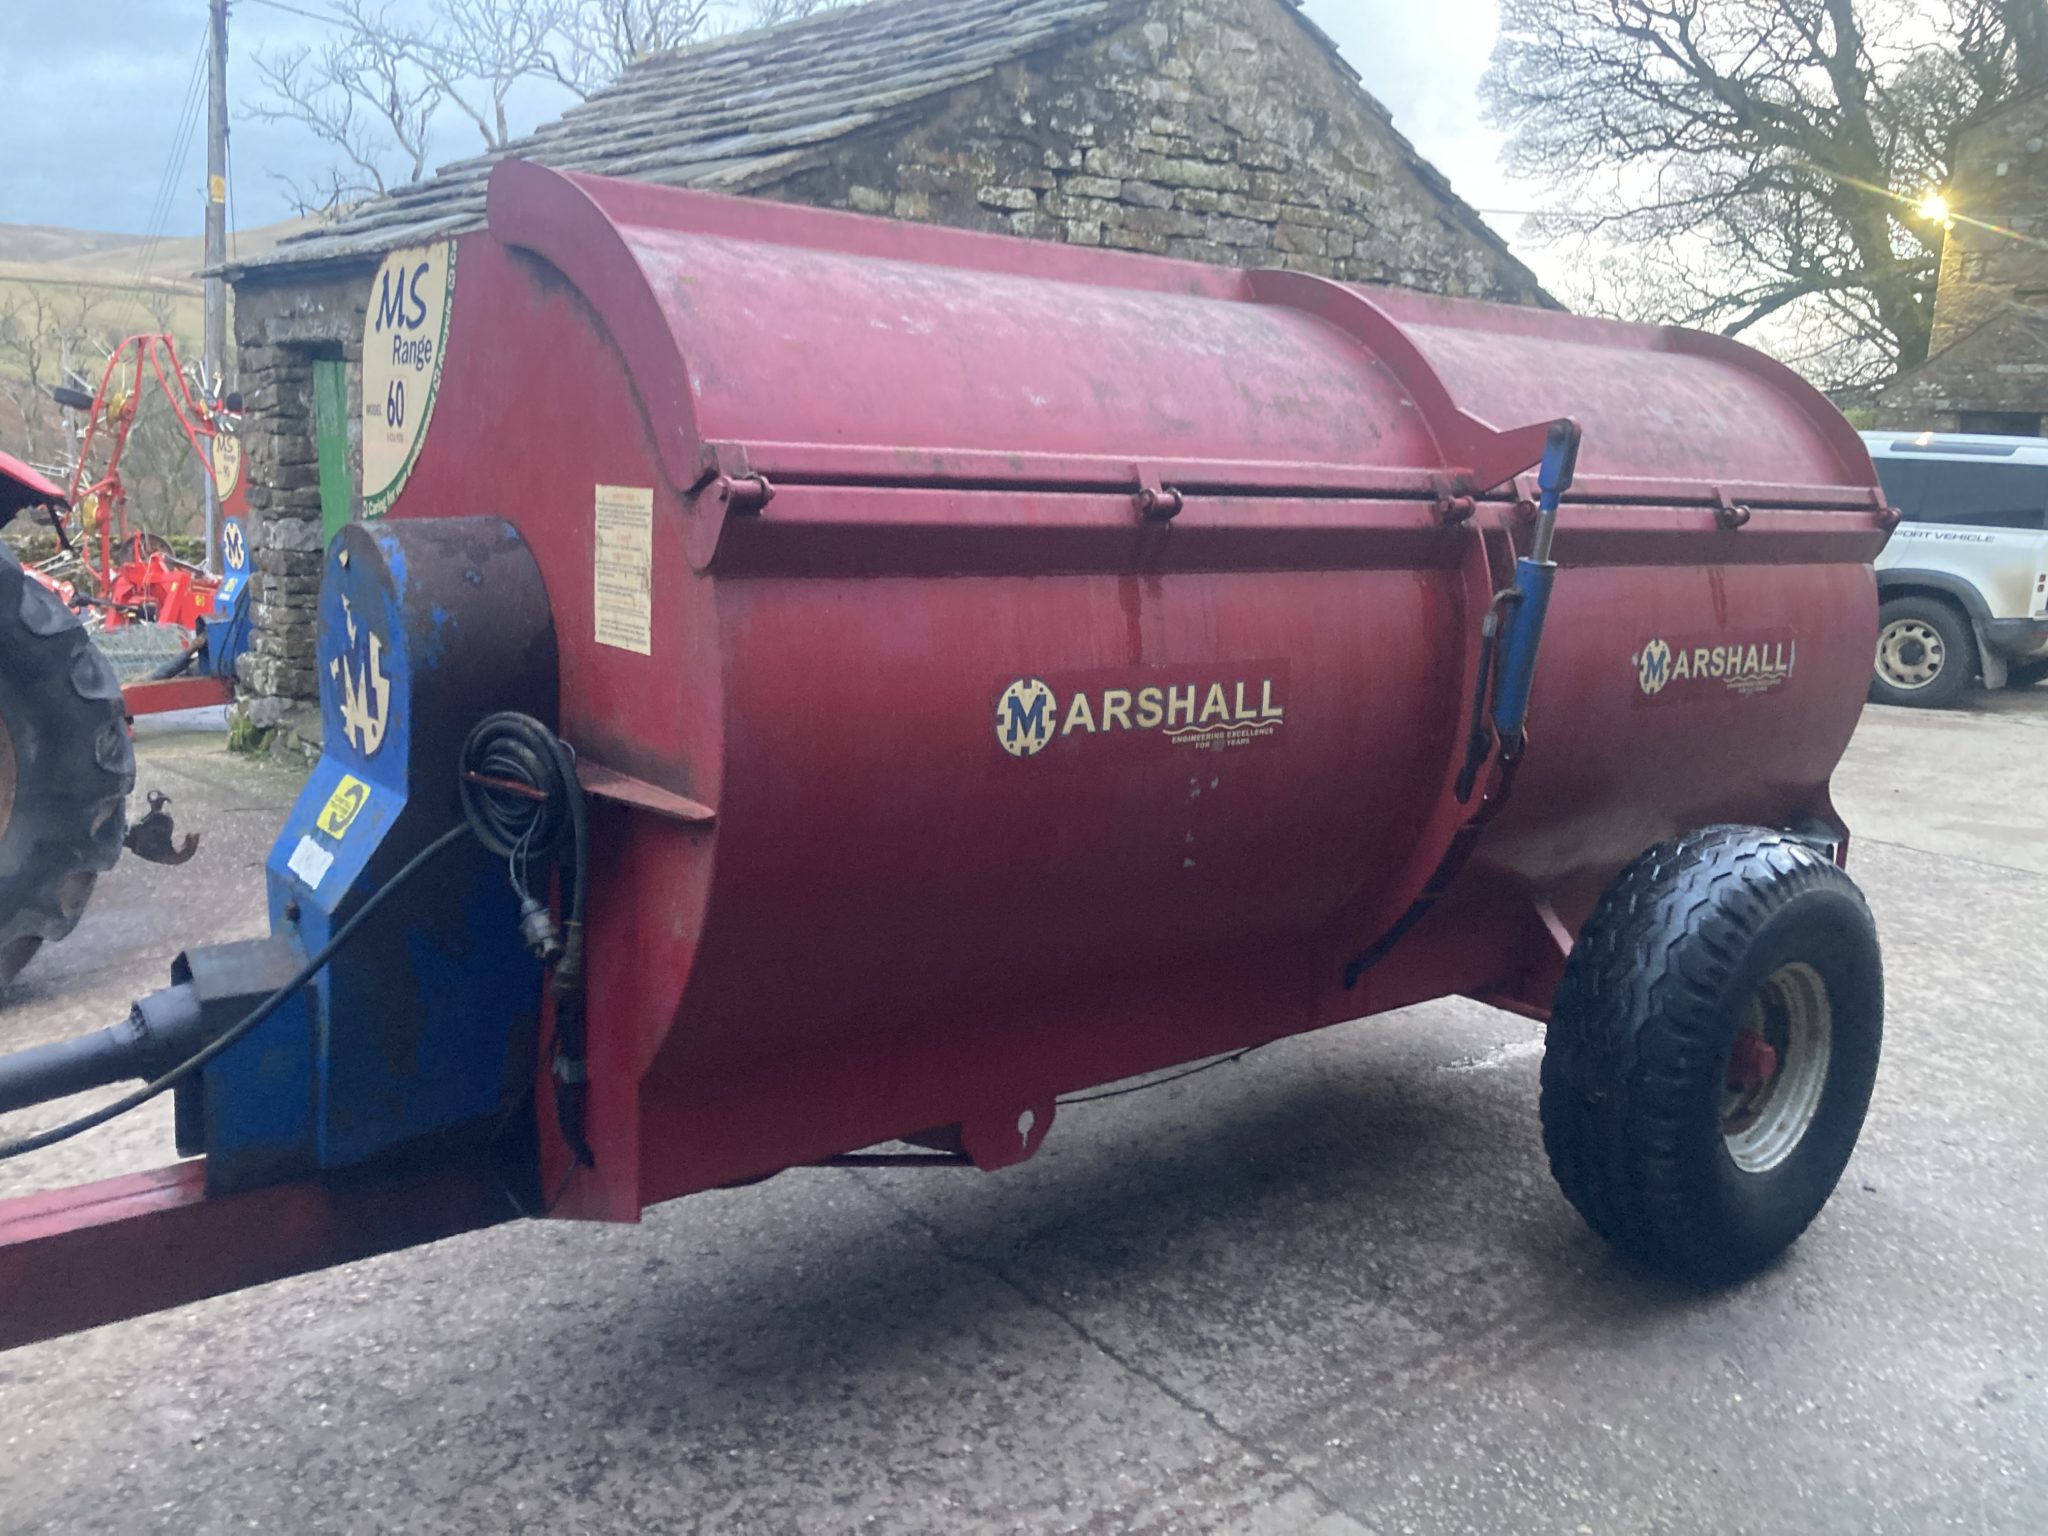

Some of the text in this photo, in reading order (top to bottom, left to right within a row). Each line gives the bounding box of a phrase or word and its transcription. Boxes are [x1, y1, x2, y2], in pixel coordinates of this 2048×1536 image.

[375, 262, 430, 332] MS
[393, 335, 432, 372] Range
[386, 380, 404, 428] 60
[1935, 531, 1996, 543] VEHICLE
[1643, 642, 1787, 686] MARSHALL
[1003, 680, 1283, 746] MARSHALL
[1171, 728, 1273, 744] ENGINEERING EXCELLENCE
[1195, 737, 1250, 749] FOR YEARS
